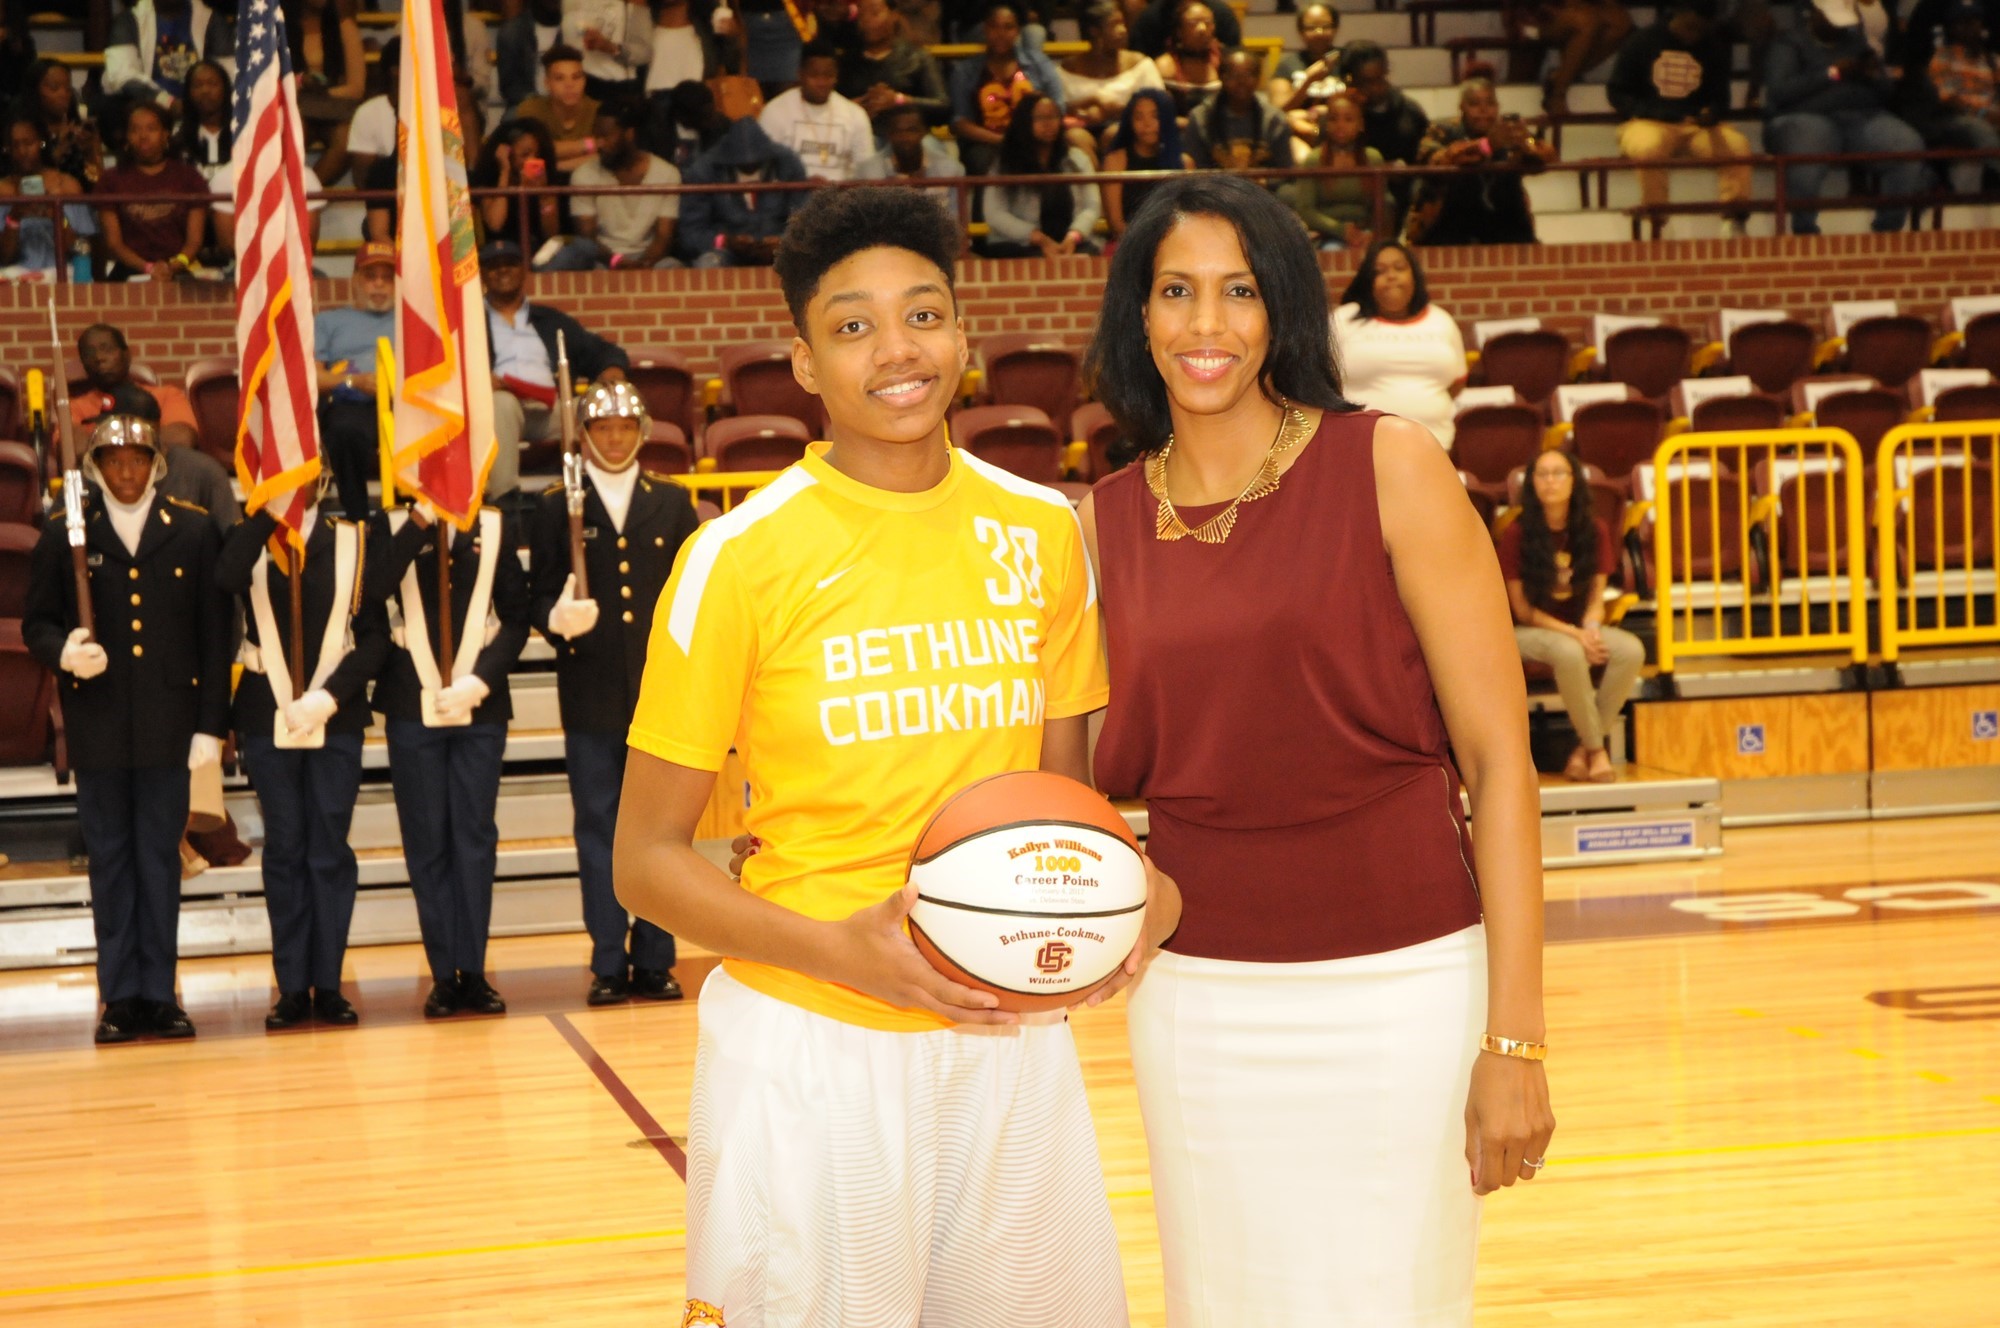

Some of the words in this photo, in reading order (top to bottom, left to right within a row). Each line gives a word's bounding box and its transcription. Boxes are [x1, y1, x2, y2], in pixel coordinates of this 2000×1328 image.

[974, 516, 1045, 609] 30
[822, 618, 1040, 682] BETHUNE
[818, 677, 1046, 746] COOKMAN
[1007, 842, 1050, 860] Kailyn
[1054, 839, 1103, 862] Williams
[1035, 855, 1082, 872] 1000
[1062, 874, 1099, 888] Points
[999, 926, 1106, 946] Bethune-Cookman
[1029, 977, 1071, 985] Wildcats
